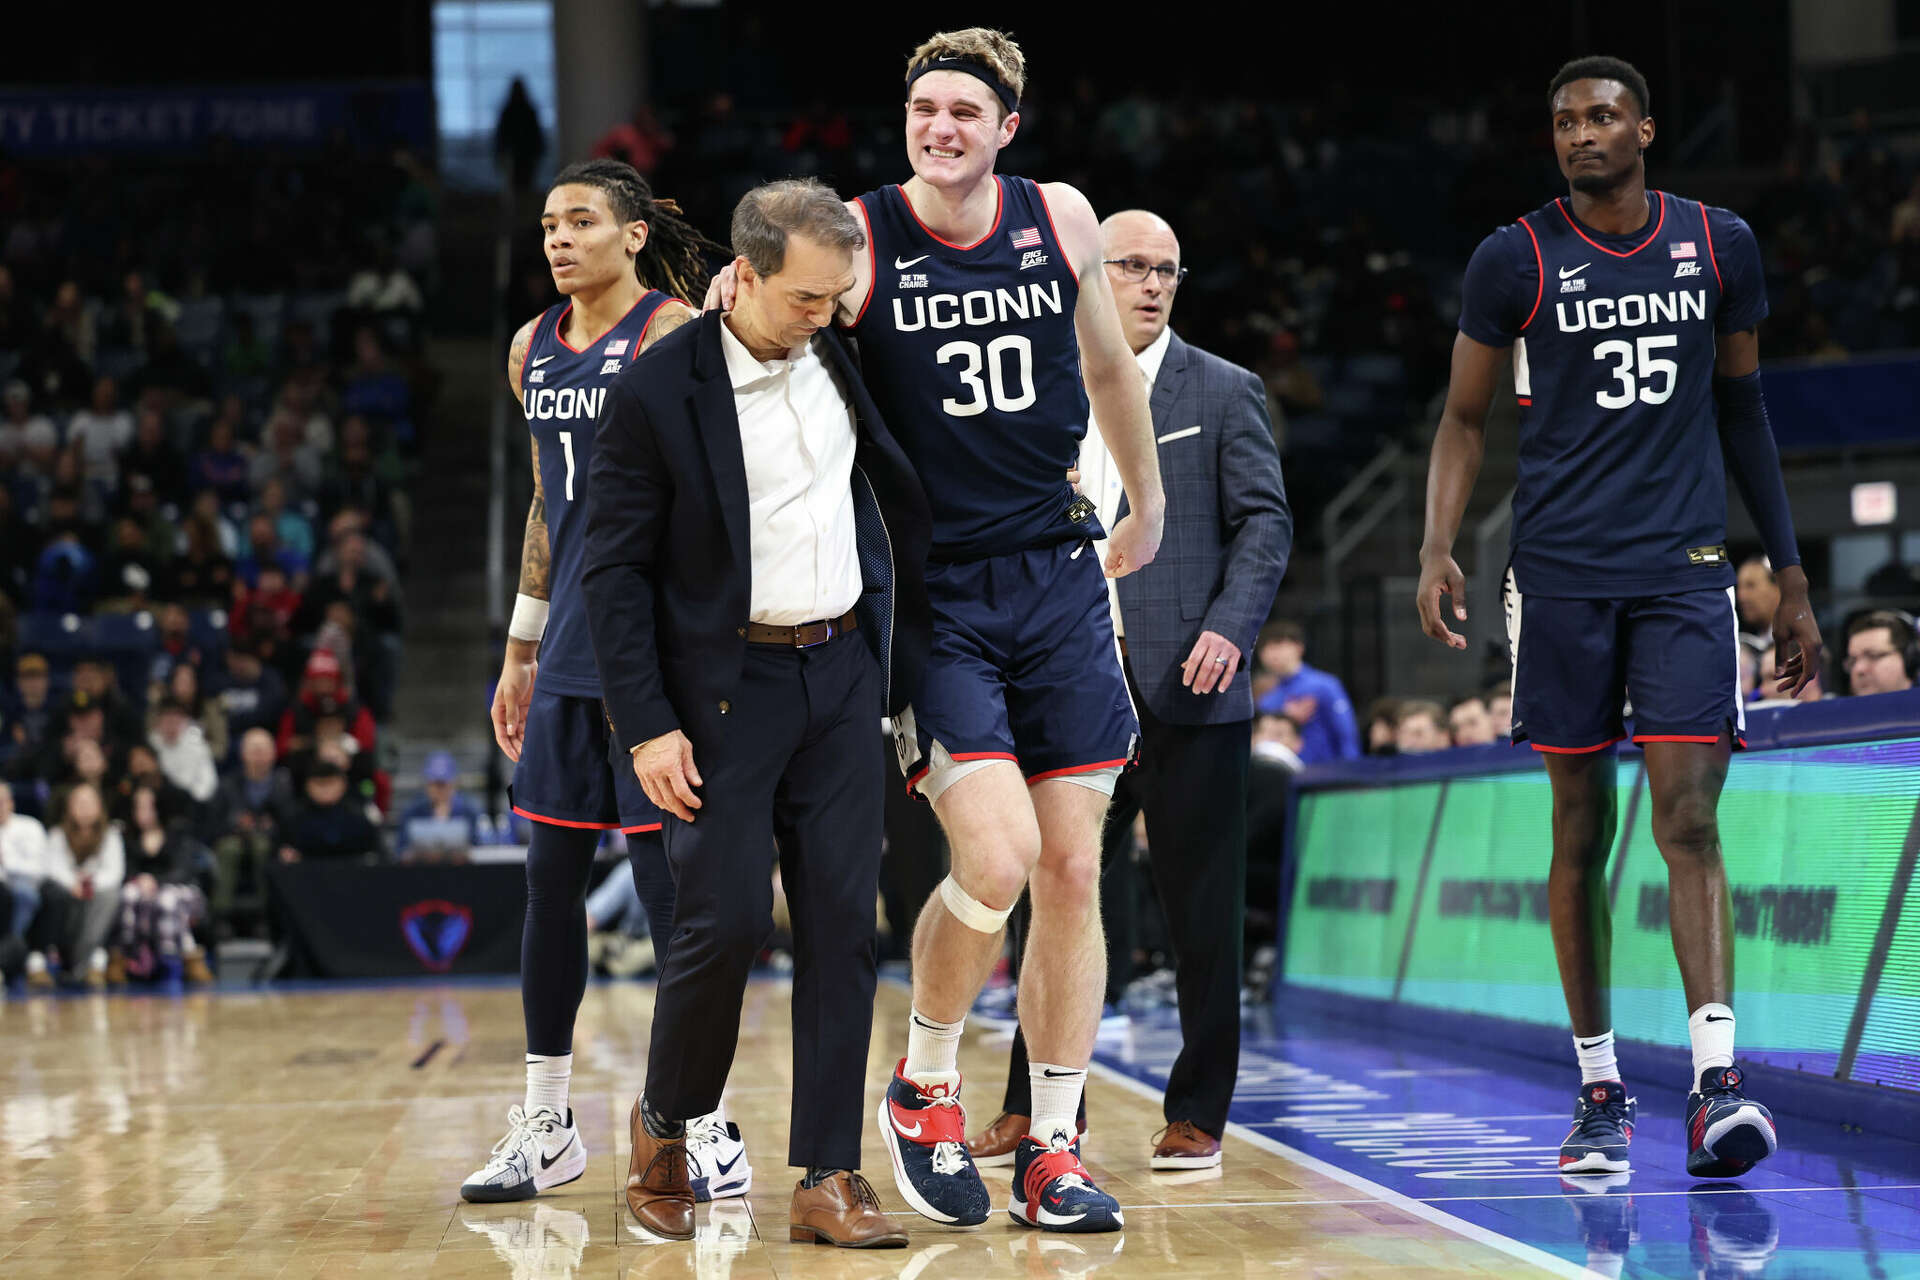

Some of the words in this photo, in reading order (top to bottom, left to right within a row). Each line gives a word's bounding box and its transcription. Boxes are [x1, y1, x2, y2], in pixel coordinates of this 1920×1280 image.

[1021, 256, 1048, 266] EAST
[1023, 250, 1041, 260] BIG
[893, 280, 1062, 332] UCONN
[899, 280, 928, 288] CHANGE
[1556, 290, 1706, 333] UCONN
[936, 335, 1037, 417] 30
[1593, 335, 1678, 410] 35
[559, 431, 575, 501] 1
